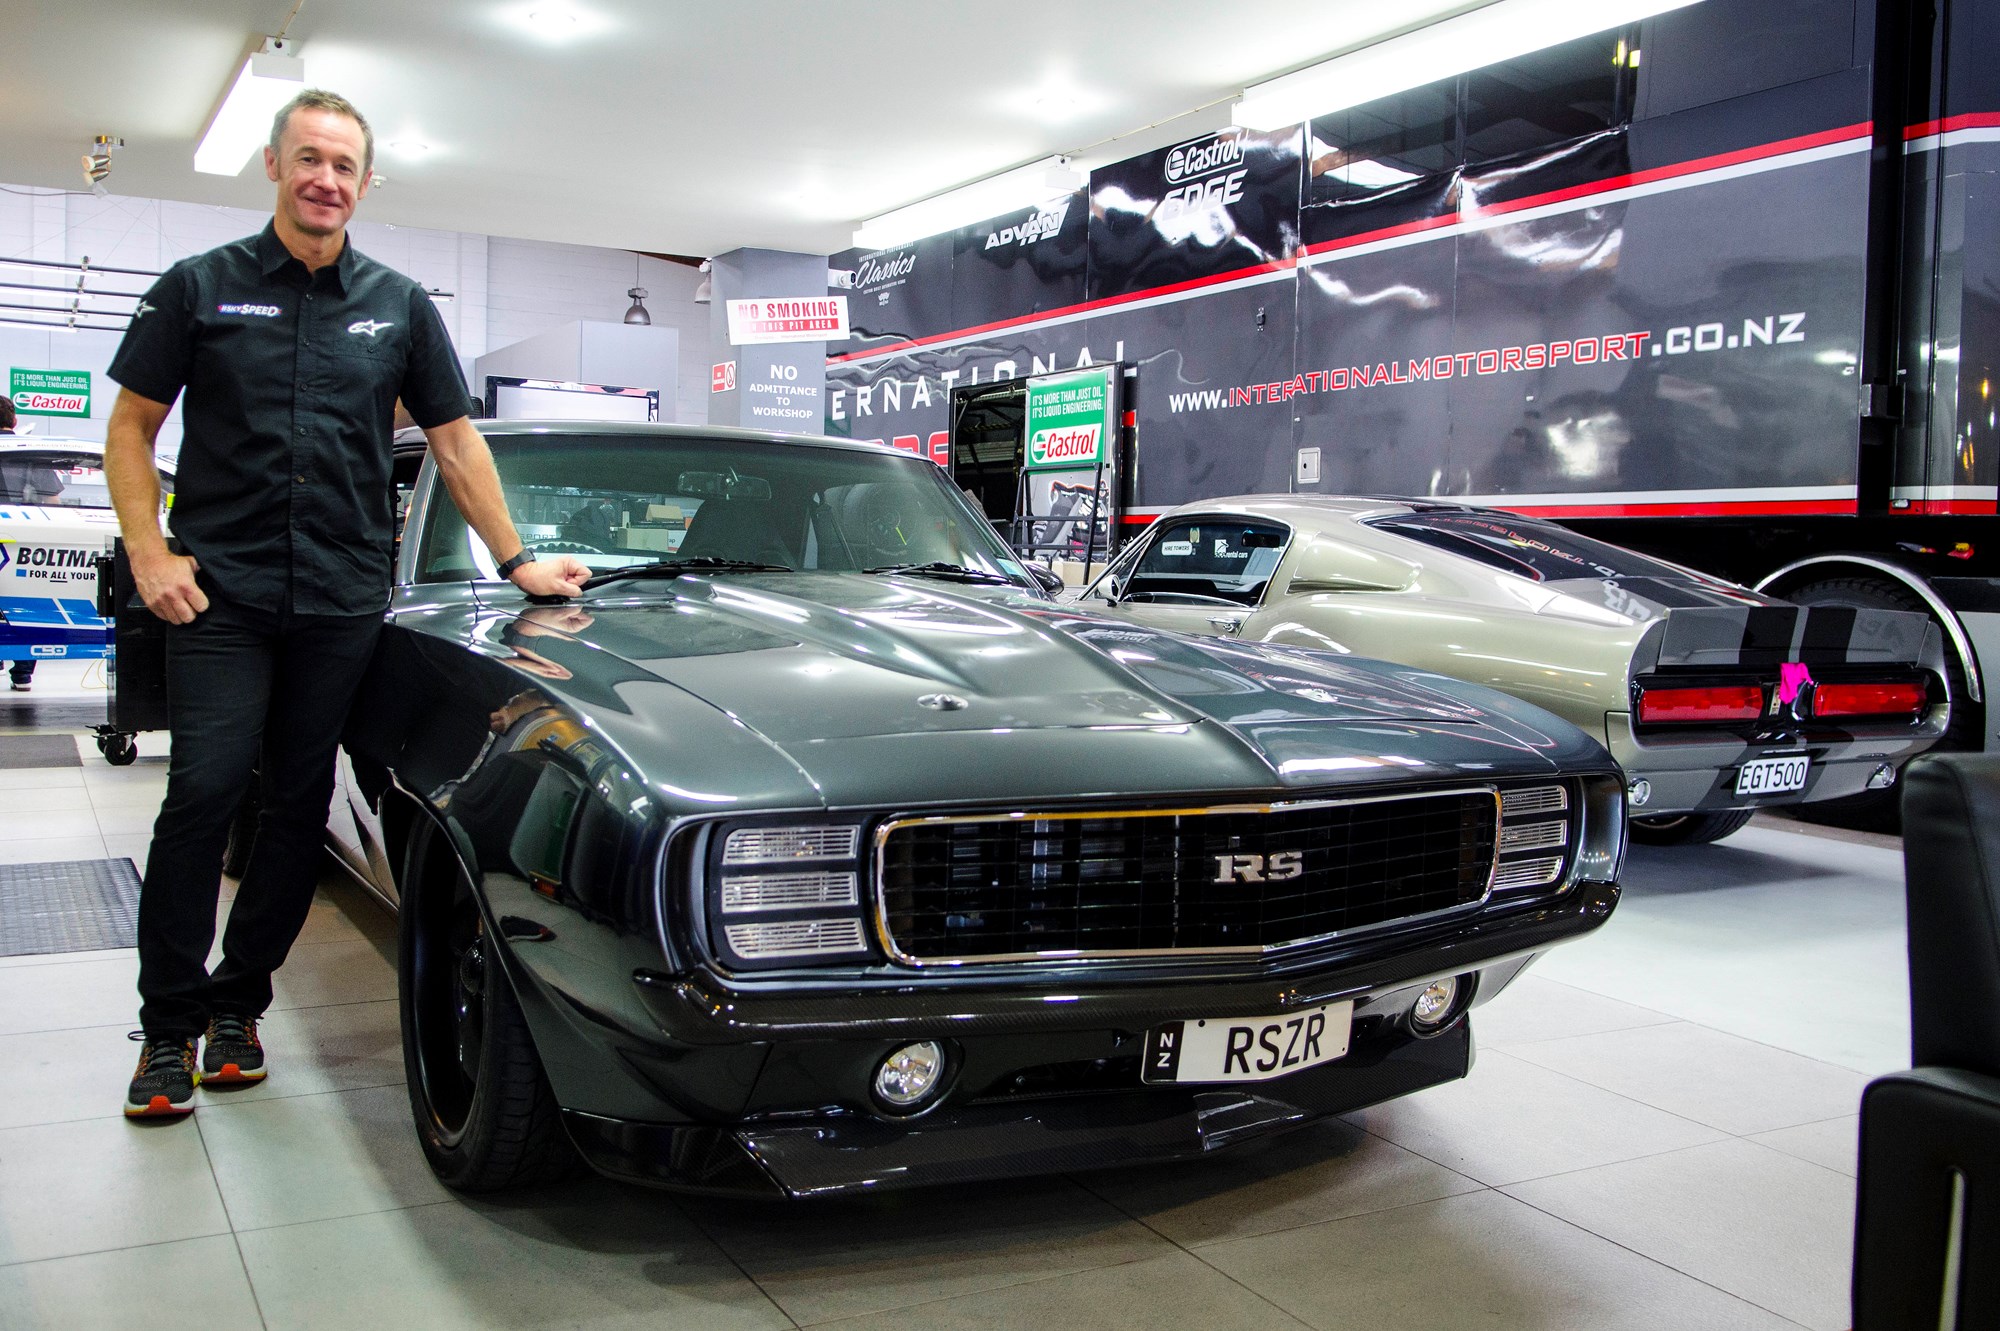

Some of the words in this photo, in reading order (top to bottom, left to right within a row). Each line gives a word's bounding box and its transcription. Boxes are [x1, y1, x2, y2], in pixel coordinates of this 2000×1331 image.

[1184, 132, 1241, 175] Castrol
[1163, 169, 1248, 220] EDGE
[985, 210, 1062, 250] ADVAN
[856, 251, 916, 289] Classics
[738, 304, 759, 319] NO
[767, 301, 838, 319] SMOKING
[763, 321, 784, 331] THIS
[789, 320, 803, 330] PIT
[809, 318, 832, 329] AREA
[770, 364, 798, 380] NO
[27, 380, 46, 388] LIQUID
[749, 383, 817, 397] ADMITTANCE
[31, 395, 82, 410] Castrol
[776, 396, 791, 406] TO
[1032, 395, 1043, 406] IT'S
[1043, 391, 1060, 405] MORE
[1060, 389, 1075, 403] THAN
[1077, 387, 1091, 400] JUST
[753, 406, 813, 419] WORKSHOP
[1032, 406, 1043, 418] IT'S
[1043, 404, 1062, 418] LIQUID
[1047, 428, 1096, 458] Castrol
[29, 570, 48, 579] FOR
[50, 571, 67, 580] ALL
[70, 572, 96, 580] YOUR
[1739, 761, 1806, 791] EGT500
[1214, 851, 1303, 884] RS
[1224, 1013, 1326, 1074] RSZR
